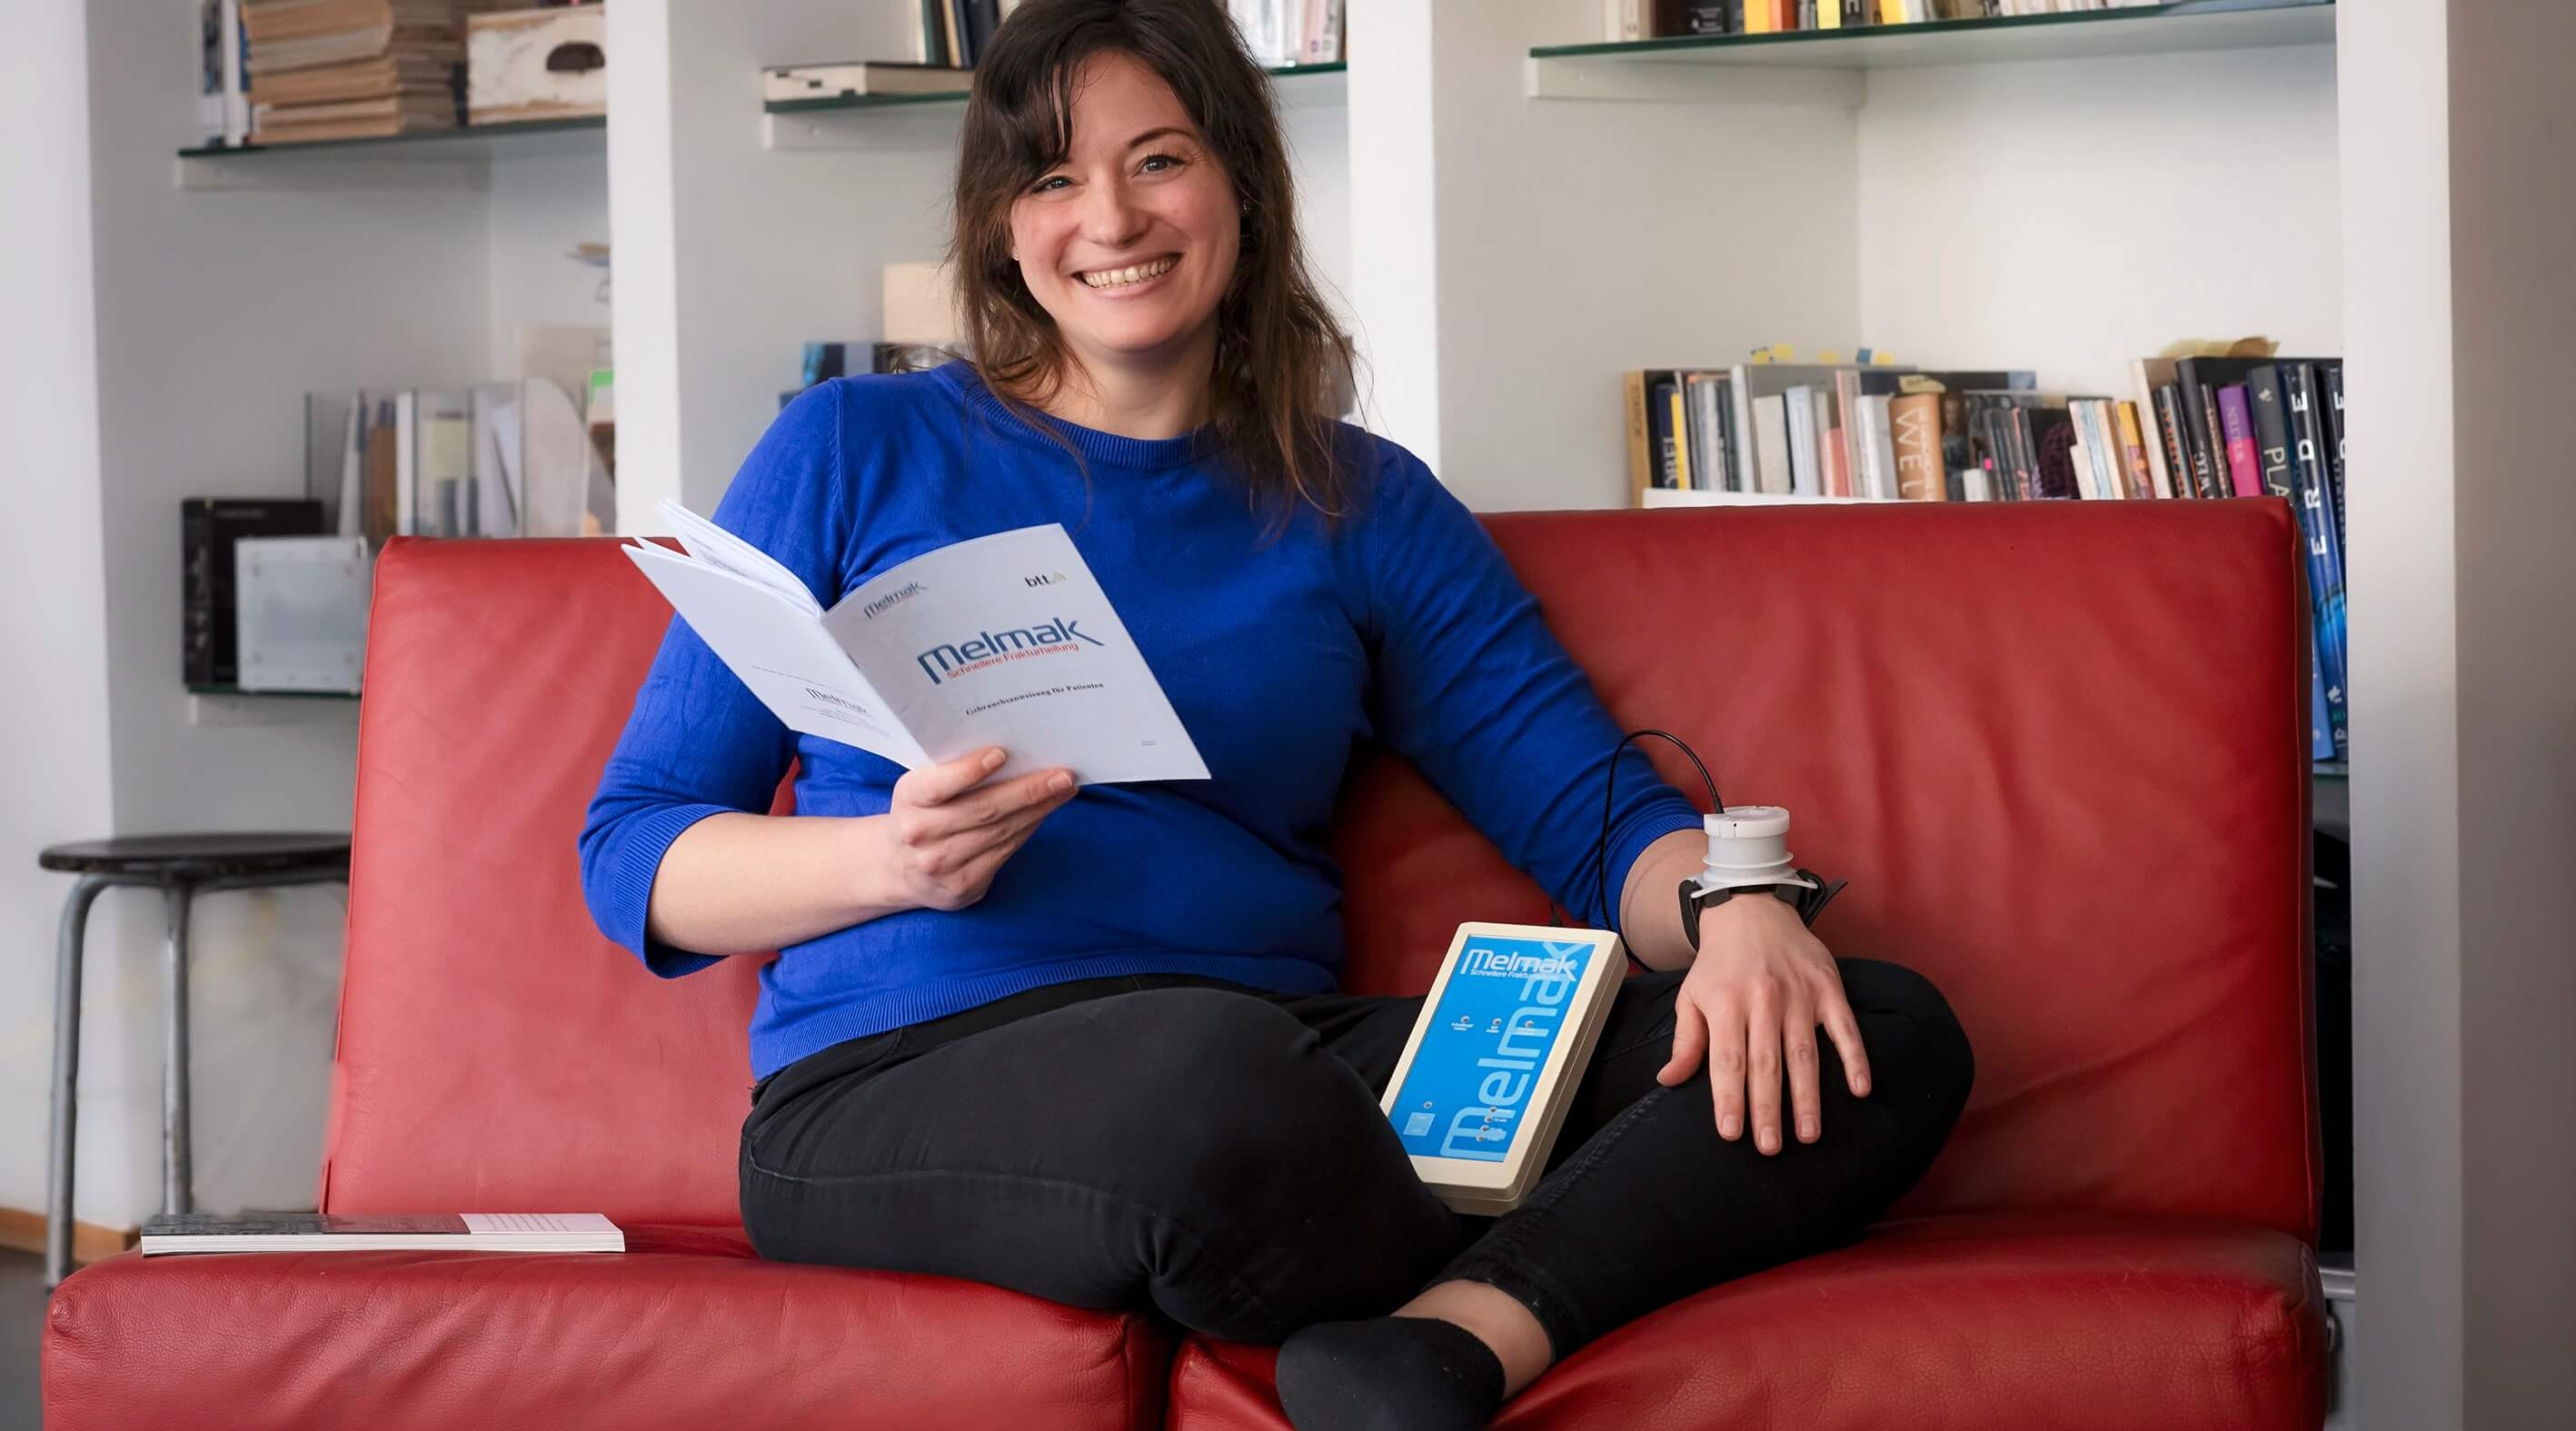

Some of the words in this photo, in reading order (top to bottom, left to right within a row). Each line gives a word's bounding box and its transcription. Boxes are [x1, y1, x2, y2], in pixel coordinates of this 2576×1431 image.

[1895, 406, 1924, 499] WEL
[2291, 391, 2327, 555] ERDE
[917, 617, 1105, 685] Melmak
[1460, 949, 1578, 982] Melmak
